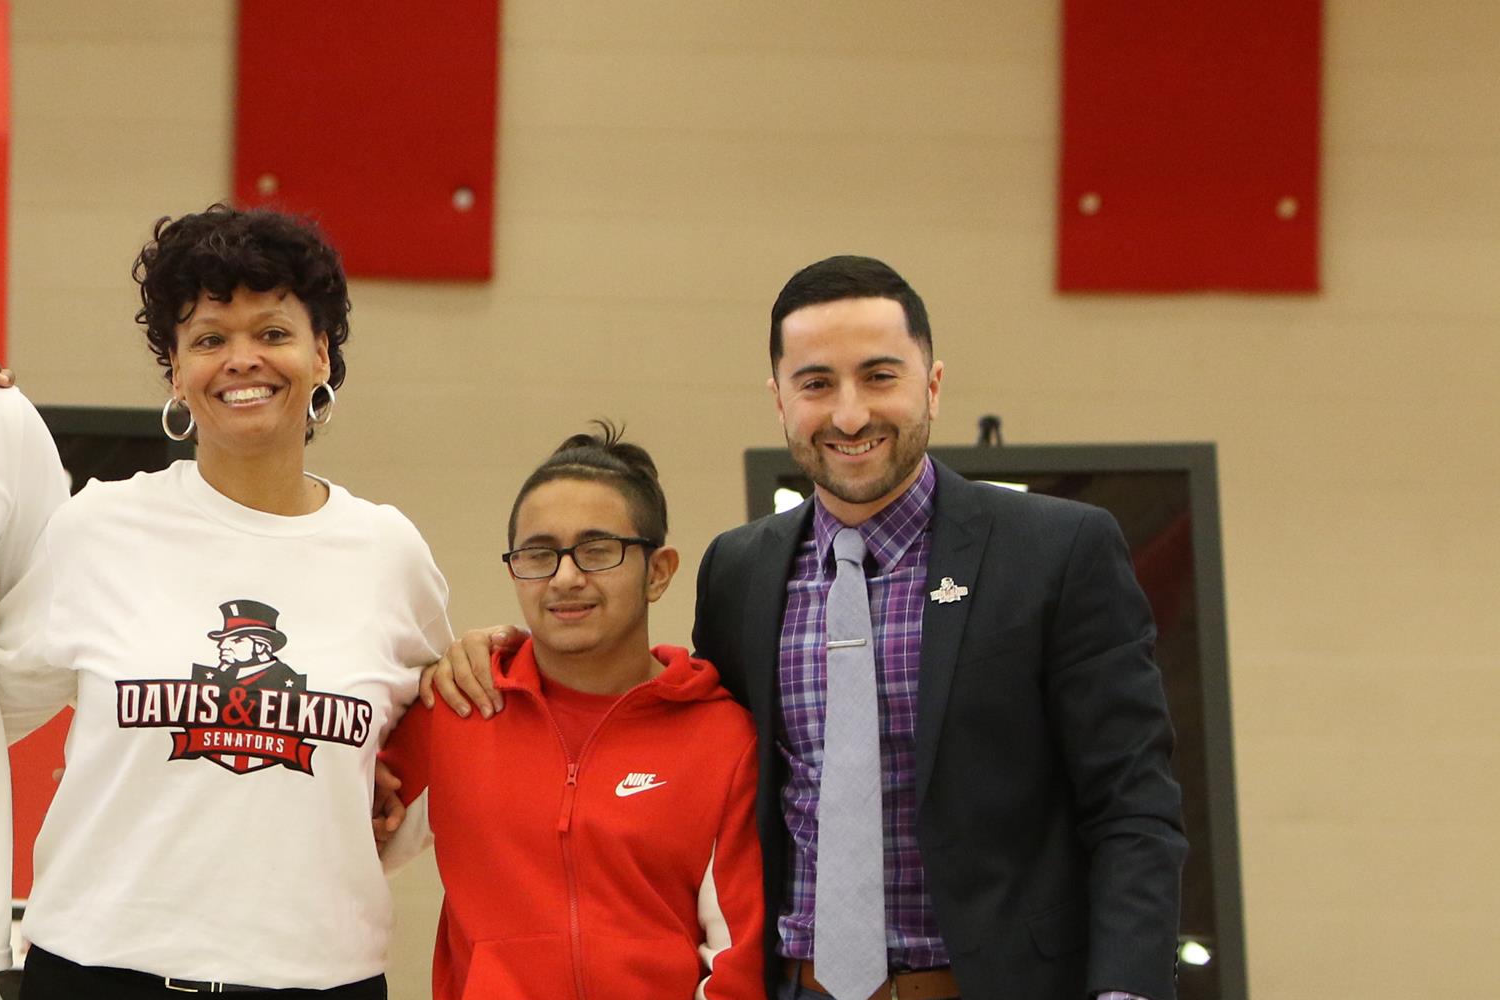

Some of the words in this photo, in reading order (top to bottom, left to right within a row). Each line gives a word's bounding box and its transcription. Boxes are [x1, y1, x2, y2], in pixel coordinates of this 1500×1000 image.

[121, 683, 220, 724] DAVIS
[222, 687, 255, 727] &
[259, 689, 372, 743] ELKINS
[203, 731, 285, 753] SENATORS
[623, 772, 657, 787] NIKE
